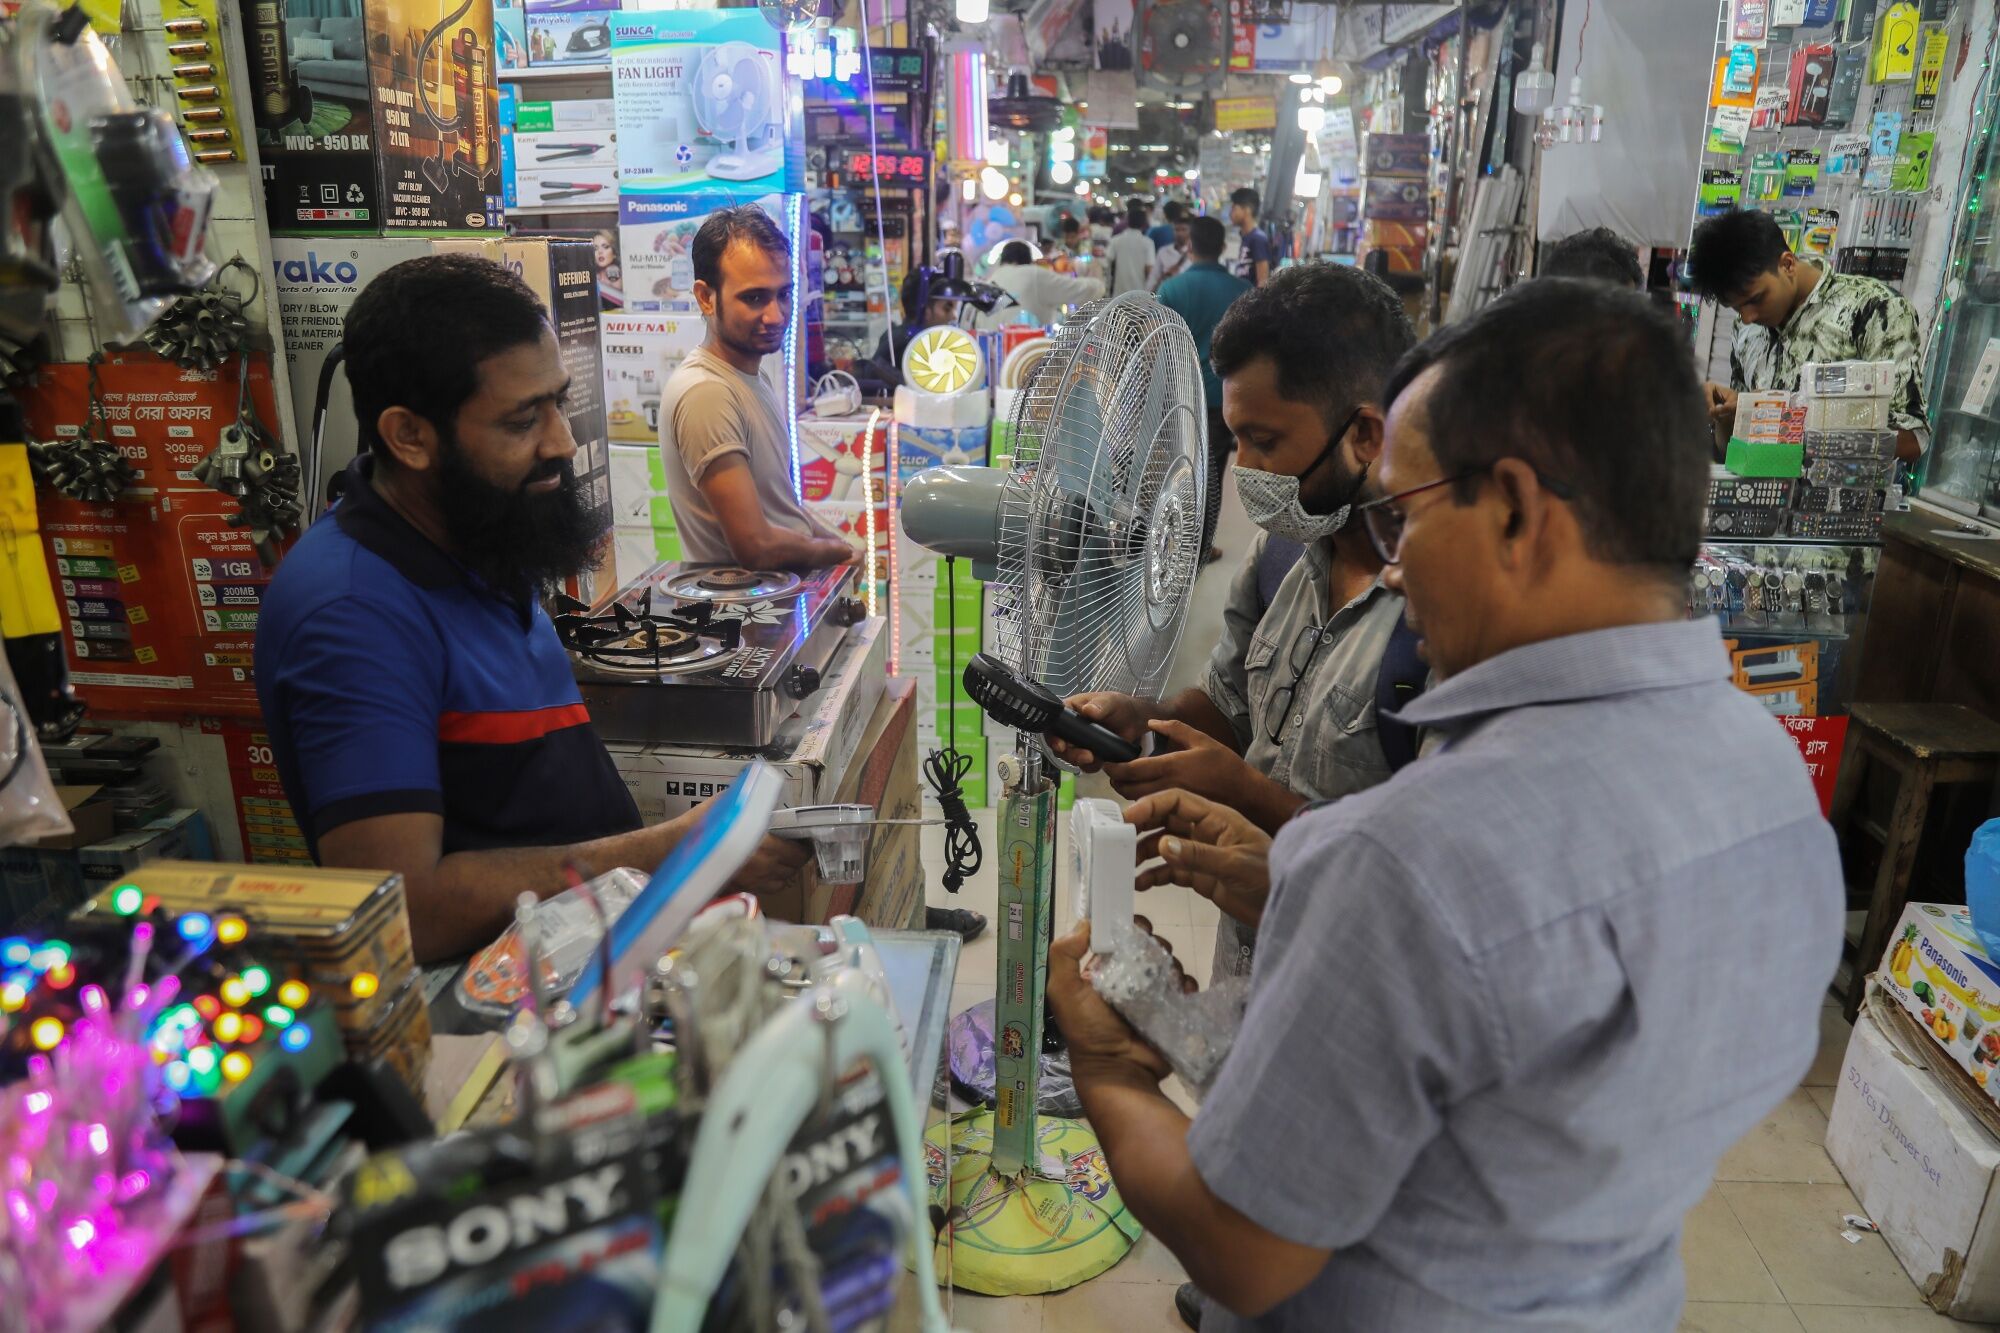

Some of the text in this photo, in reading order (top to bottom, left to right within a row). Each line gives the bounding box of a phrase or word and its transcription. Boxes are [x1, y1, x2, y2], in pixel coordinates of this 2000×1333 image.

[615, 26, 653, 36] SUNCA
[618, 66, 683, 79] FAN LIGHT
[378, 88, 414, 108] 1800 WATT
[386, 110, 410, 127] 950 BK
[285, 135, 314, 151] MVC
[323, 134, 349, 151] 950
[351, 134, 369, 150] BK
[398, 133, 410, 147] LTR
[1833, 141, 1868, 153] Energizer
[260, 165, 275, 179] TT
[1713, 177, 1738, 185] SONY
[628, 201, 688, 213] Panasonic
[558, 271, 591, 287] DEFENDER
[283, 304, 302, 313] DRY
[310, 304, 338, 313] BLOW
[281, 317, 299, 326] SER
[606, 323, 665, 332] NOVENA
[302, 330, 343, 338] MATERIA
[286, 342, 324, 350] LEANER
[127, 393, 158, 402] FASTEST
[135, 406, 165, 420] সেরা
[168, 406, 212, 420] অফার
[174, 454, 199, 464] +5GB
[900, 456, 930, 465] CLICK
[197, 532, 218, 544] নতুন
[221, 562, 252, 576] 1GB
[224, 587, 255, 596] 300MB
[738, 647, 776, 679] GALAXY
[1920, 936, 1968, 989] Panasonic
[1848, 1066, 1943, 1187] 52 Pcs Dinner Set
[782, 1115, 880, 1200] ONY
[385, 1163, 626, 1291] SONY
